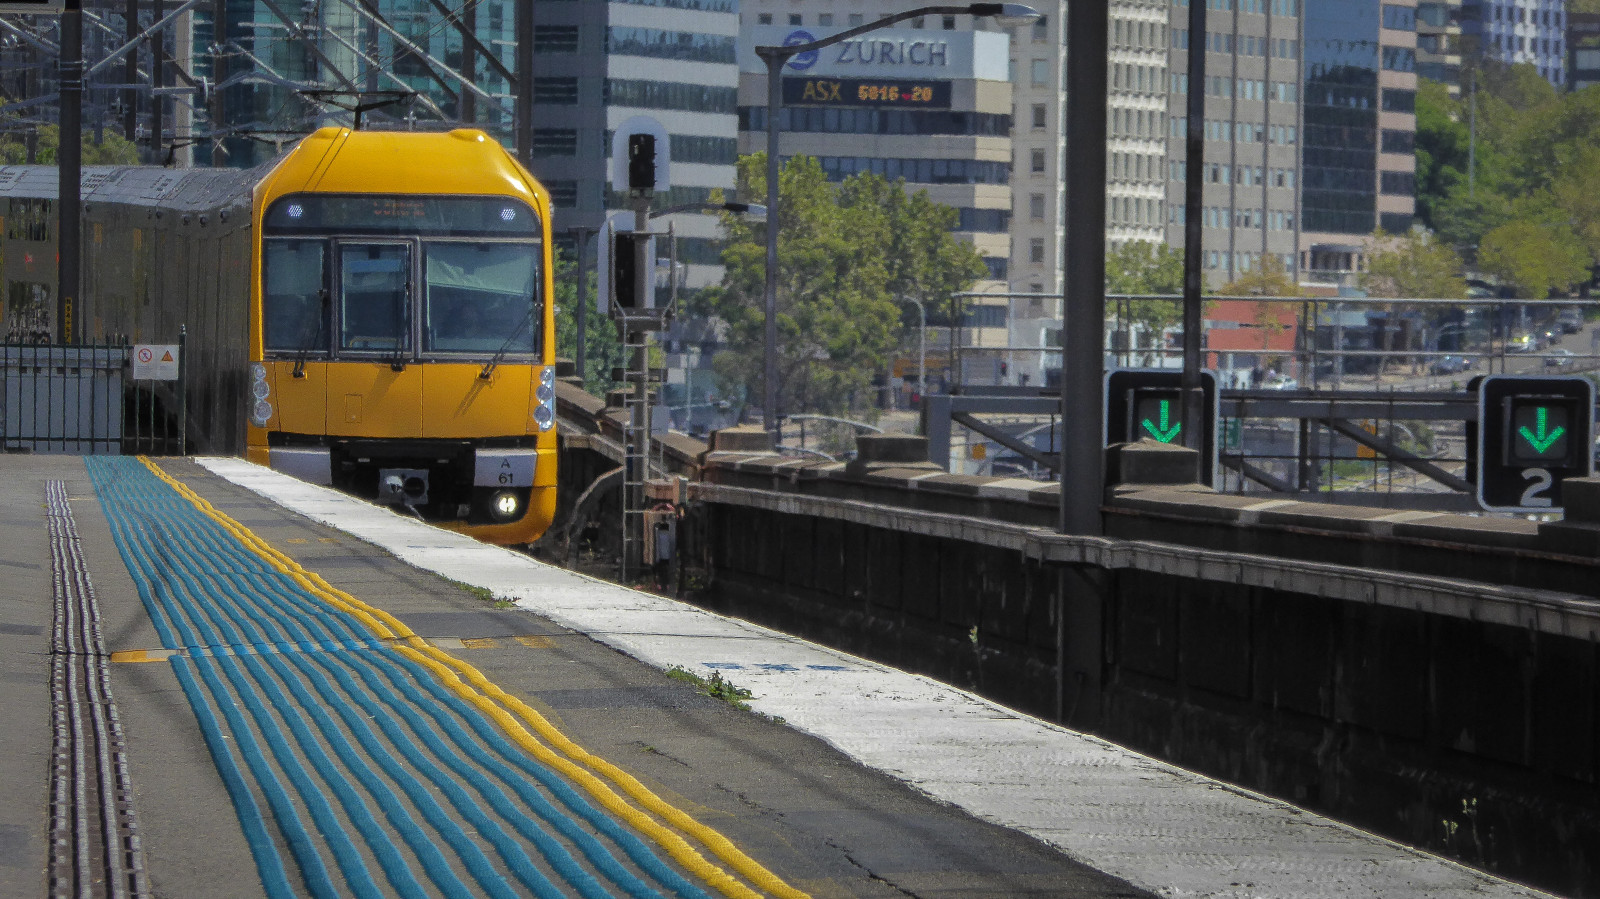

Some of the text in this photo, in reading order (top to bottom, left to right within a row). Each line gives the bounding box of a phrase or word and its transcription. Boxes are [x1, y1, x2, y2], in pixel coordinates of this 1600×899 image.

[836, 39, 948, 66] ZURICH
[802, 80, 841, 101] ASX
[501, 459, 510, 468] A
[498, 472, 513, 484] 61
[1520, 467, 1552, 507] 2
